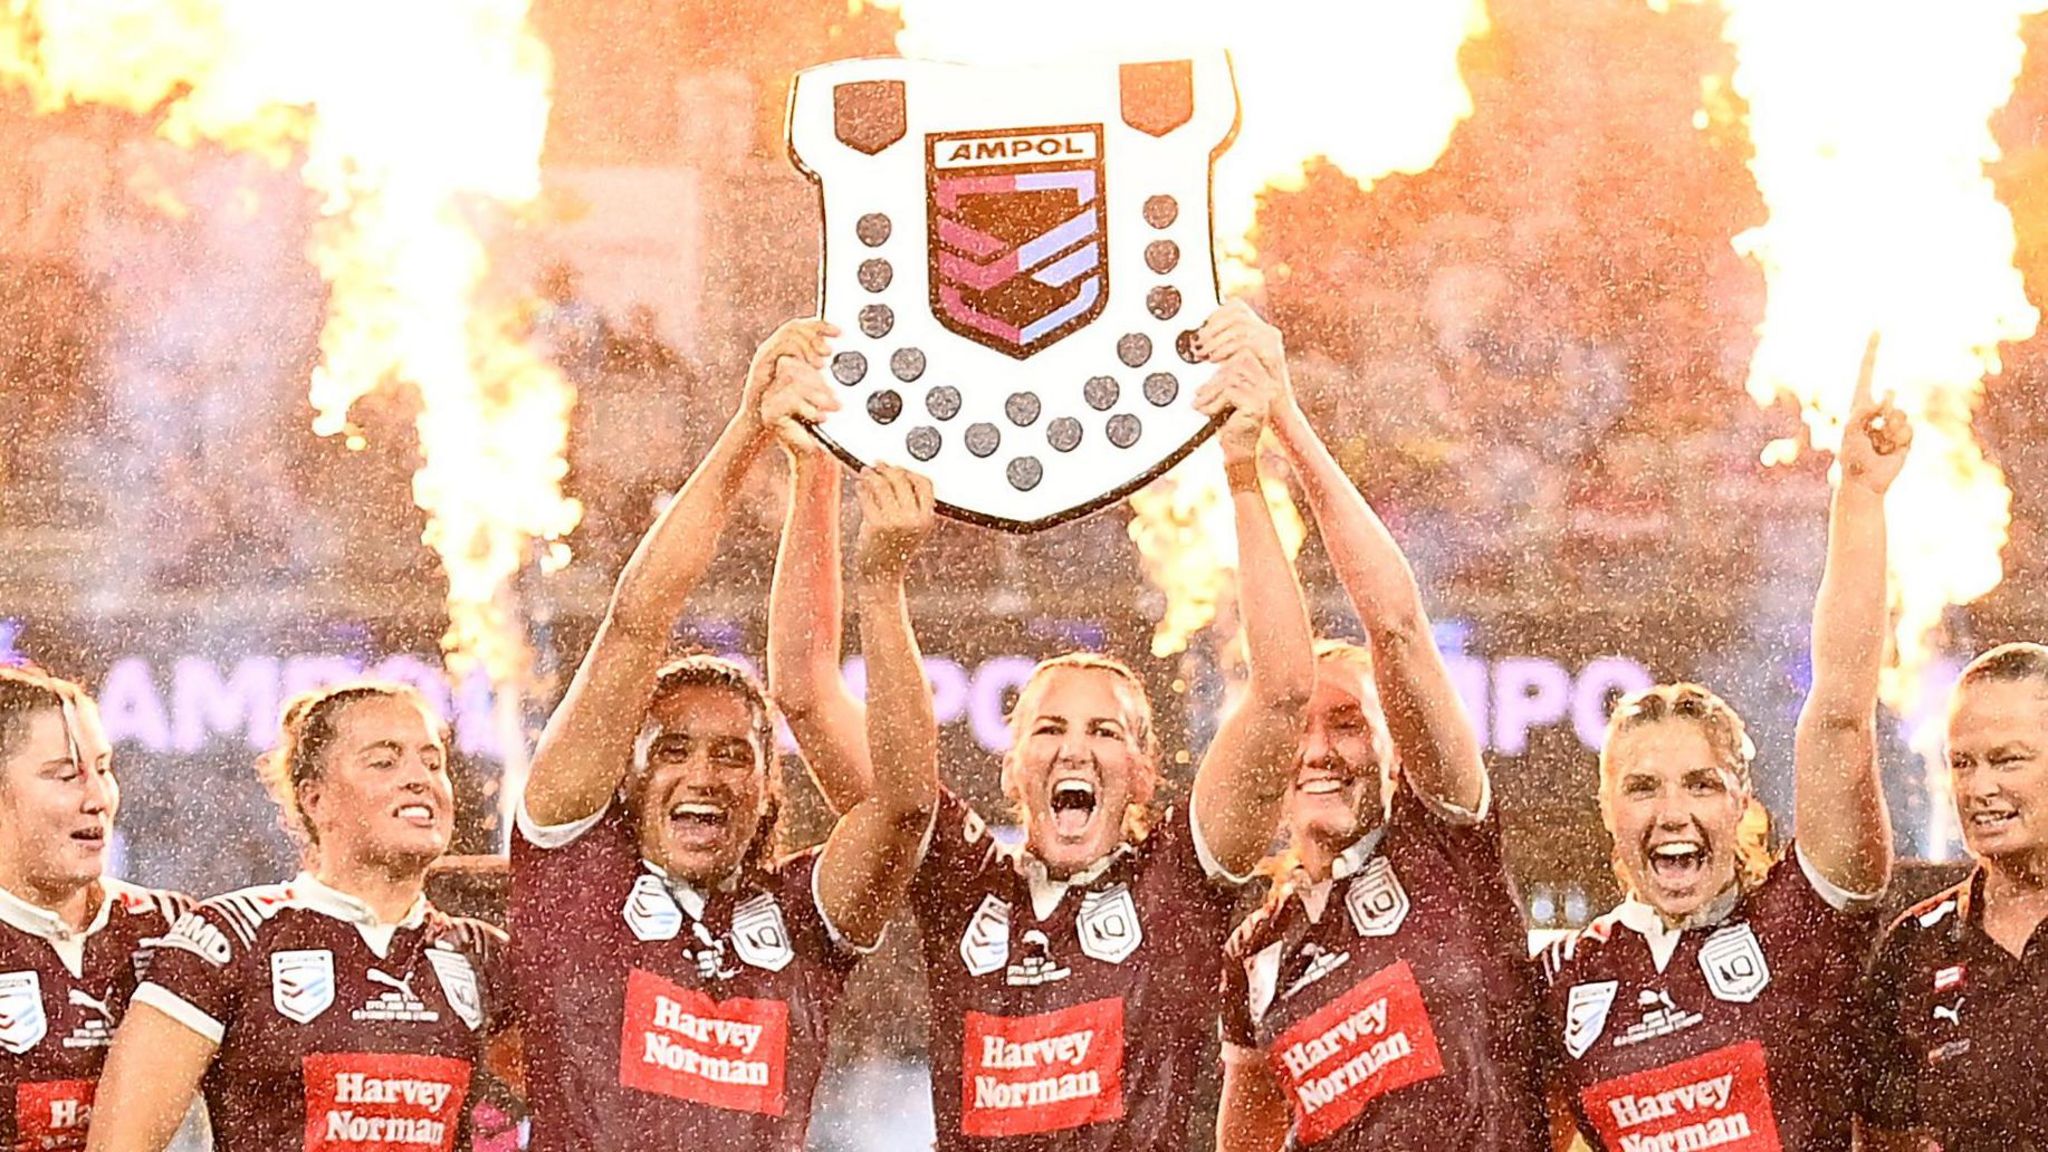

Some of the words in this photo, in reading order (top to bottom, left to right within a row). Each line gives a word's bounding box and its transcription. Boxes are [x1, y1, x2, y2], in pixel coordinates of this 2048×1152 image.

[948, 138, 1084, 162] AMPOL
[653, 996, 763, 1055] Harvey
[981, 1030, 1094, 1065] Harvey
[1282, 998, 1388, 1078] Harvey
[643, 1032, 769, 1086] Norman
[1296, 1032, 1413, 1114] Norman
[334, 1073, 452, 1113] Harvey
[974, 1070, 1100, 1108] Norman
[1608, 1073, 1733, 1129] Harvey
[325, 1110, 445, 1145] Norman
